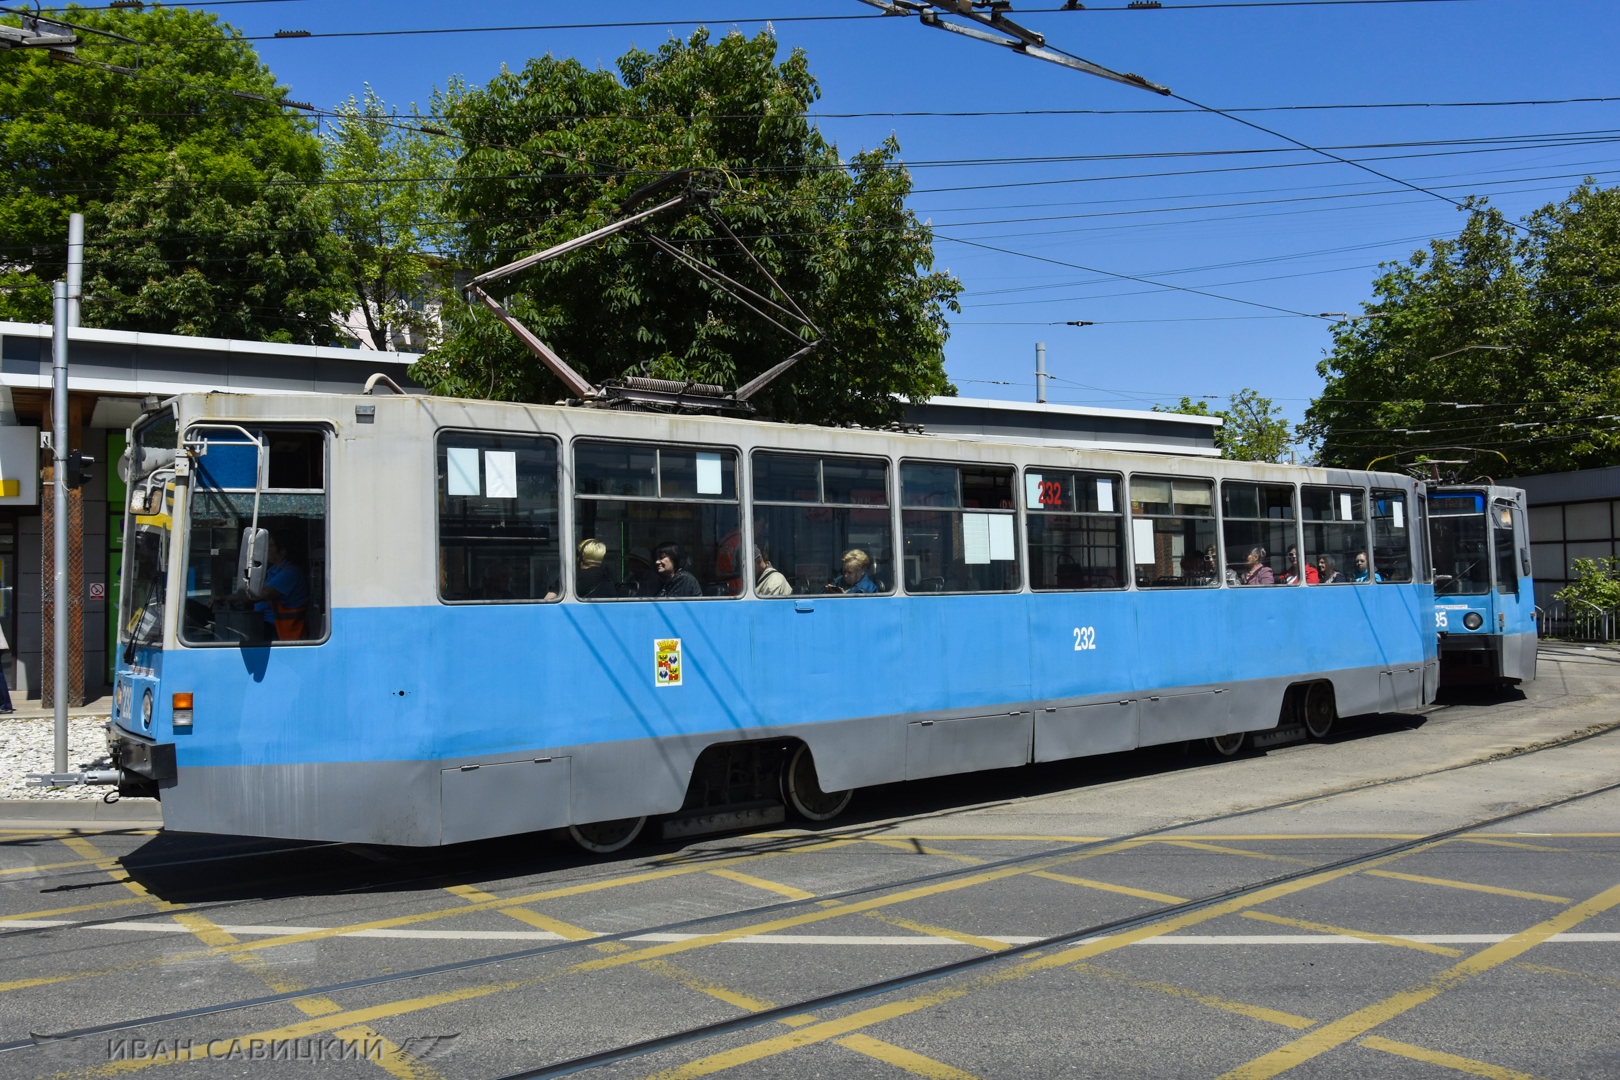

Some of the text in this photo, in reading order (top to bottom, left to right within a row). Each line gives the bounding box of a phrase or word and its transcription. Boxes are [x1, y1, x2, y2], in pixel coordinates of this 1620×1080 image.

[1038, 481, 1062, 505] 232
[1073, 626, 1096, 651] 232
[122, 685, 132, 720] 232
